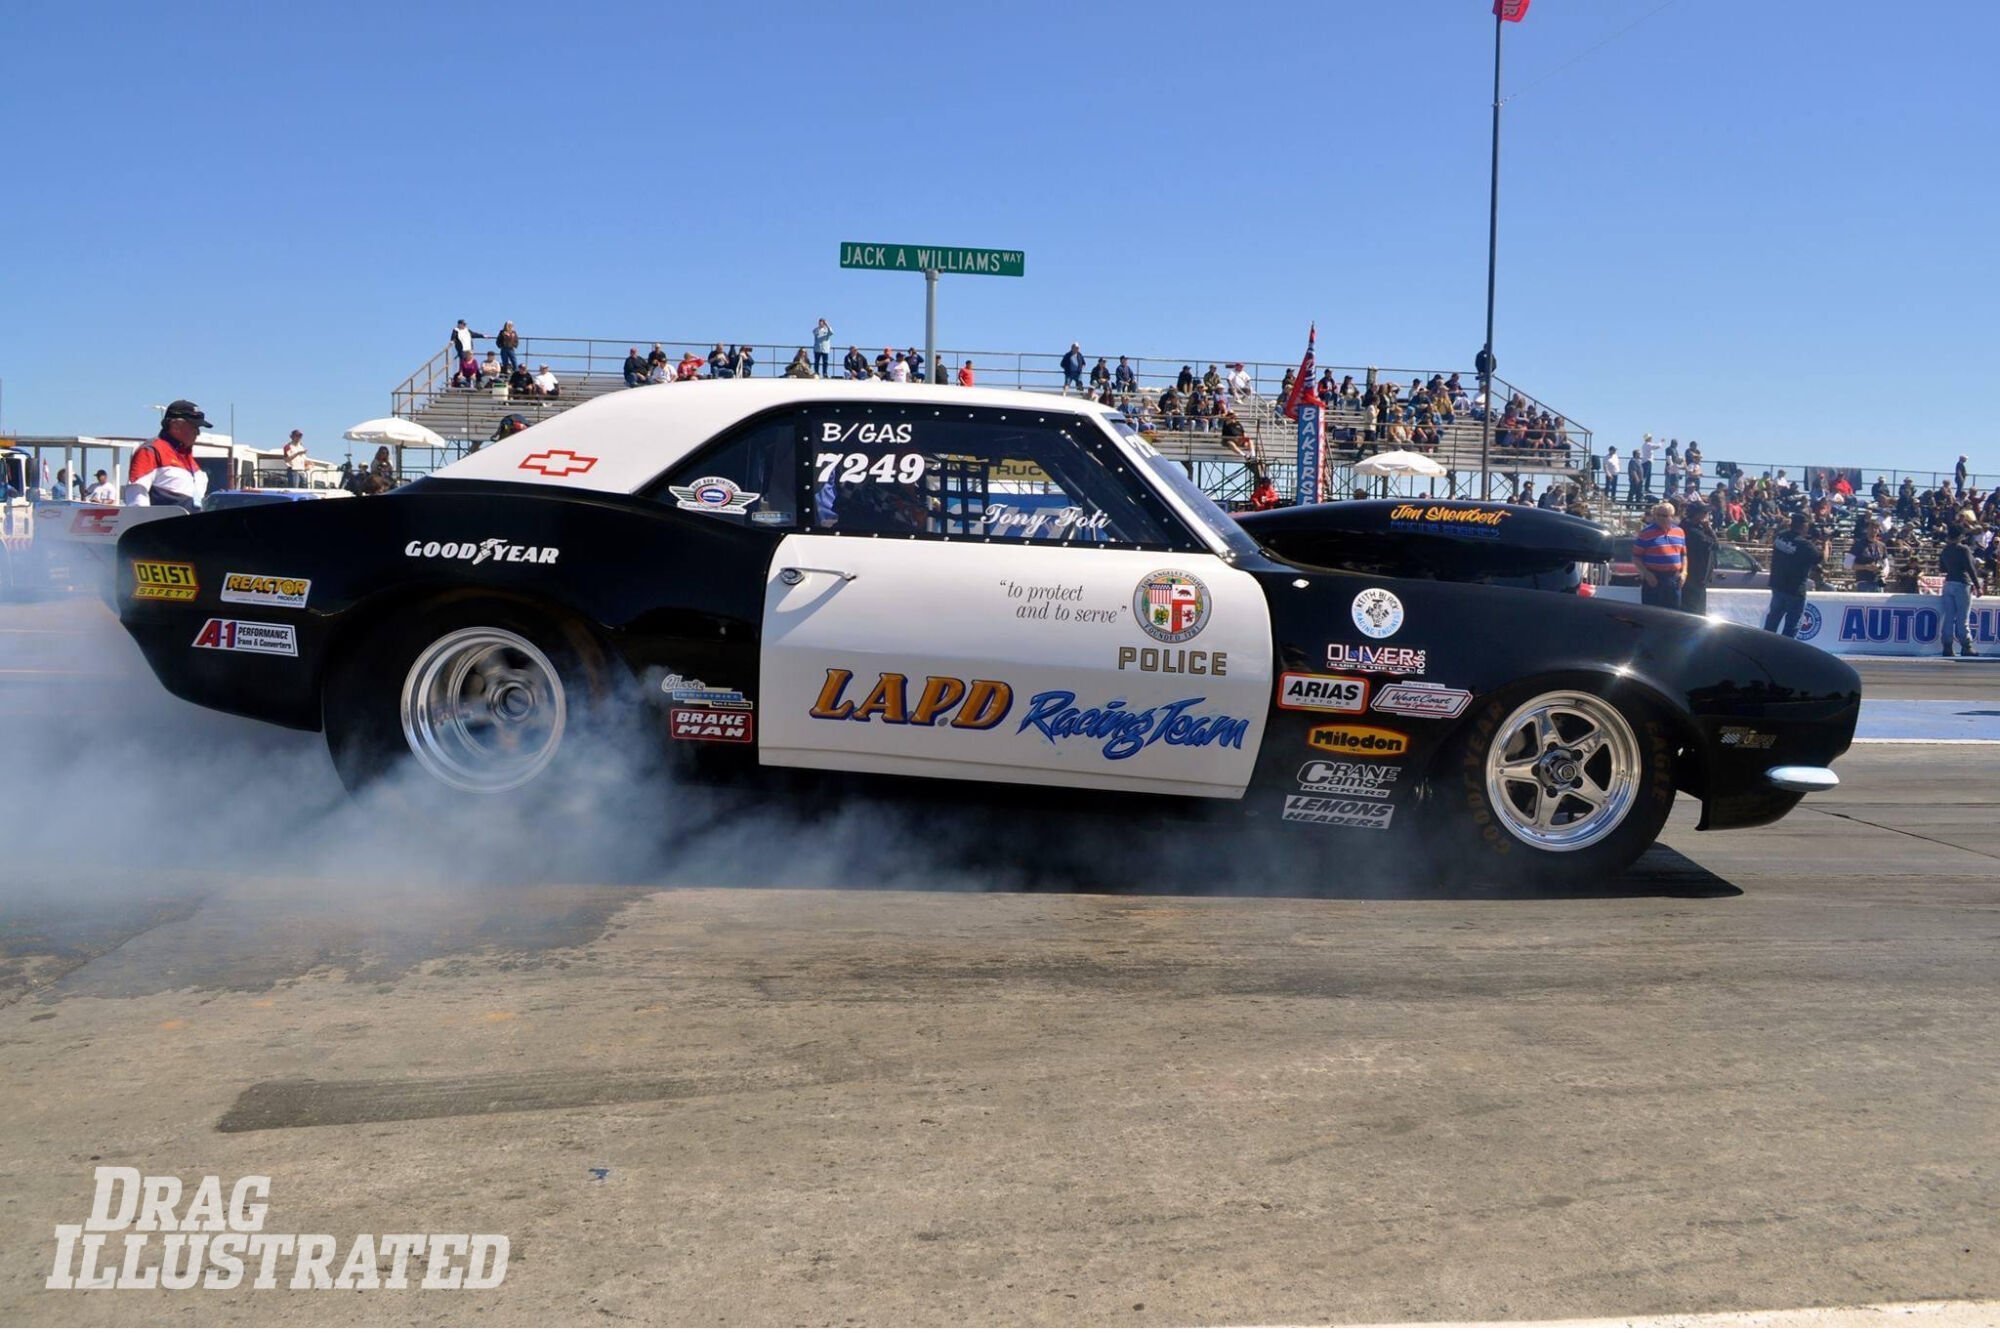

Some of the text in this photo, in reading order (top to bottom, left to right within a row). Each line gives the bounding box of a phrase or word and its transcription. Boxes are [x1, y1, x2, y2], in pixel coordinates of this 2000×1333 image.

[842, 245, 1022, 272] JACK A WILLIAMS WAY
[821, 422, 912, 443] B/GAS
[814, 453, 925, 483] 7249
[980, 503, 1052, 534] Tony
[404, 538, 560, 565] GOODYEAR
[136, 564, 191, 585] DEIST
[226, 574, 308, 596] REACTOR
[137, 587, 194, 598] SAFETY
[1028, 583, 1084, 602] protect
[1016, 601, 1050, 620] and
[1055, 604, 1070, 621] to
[238, 627, 289, 640] PERFORMANCE
[1838, 605, 1940, 645] AUTO
[1118, 646, 1228, 676] POLICE
[1327, 643, 1414, 665] OLIVER
[1287, 681, 1360, 701] ARIAS
[1296, 698, 1350, 706] PISTONS
[676, 712, 746, 726] BRAKE
[1017, 690, 1155, 761] Racing
[1144, 697, 1250, 750] Team
[677, 725, 745, 737] MAN
[1314, 730, 1403, 751] Milodon
[1303, 785, 1389, 796] ROCKERS
[1287, 797, 1393, 818] LEMONS
[1285, 812, 1385, 827] HEADERS
